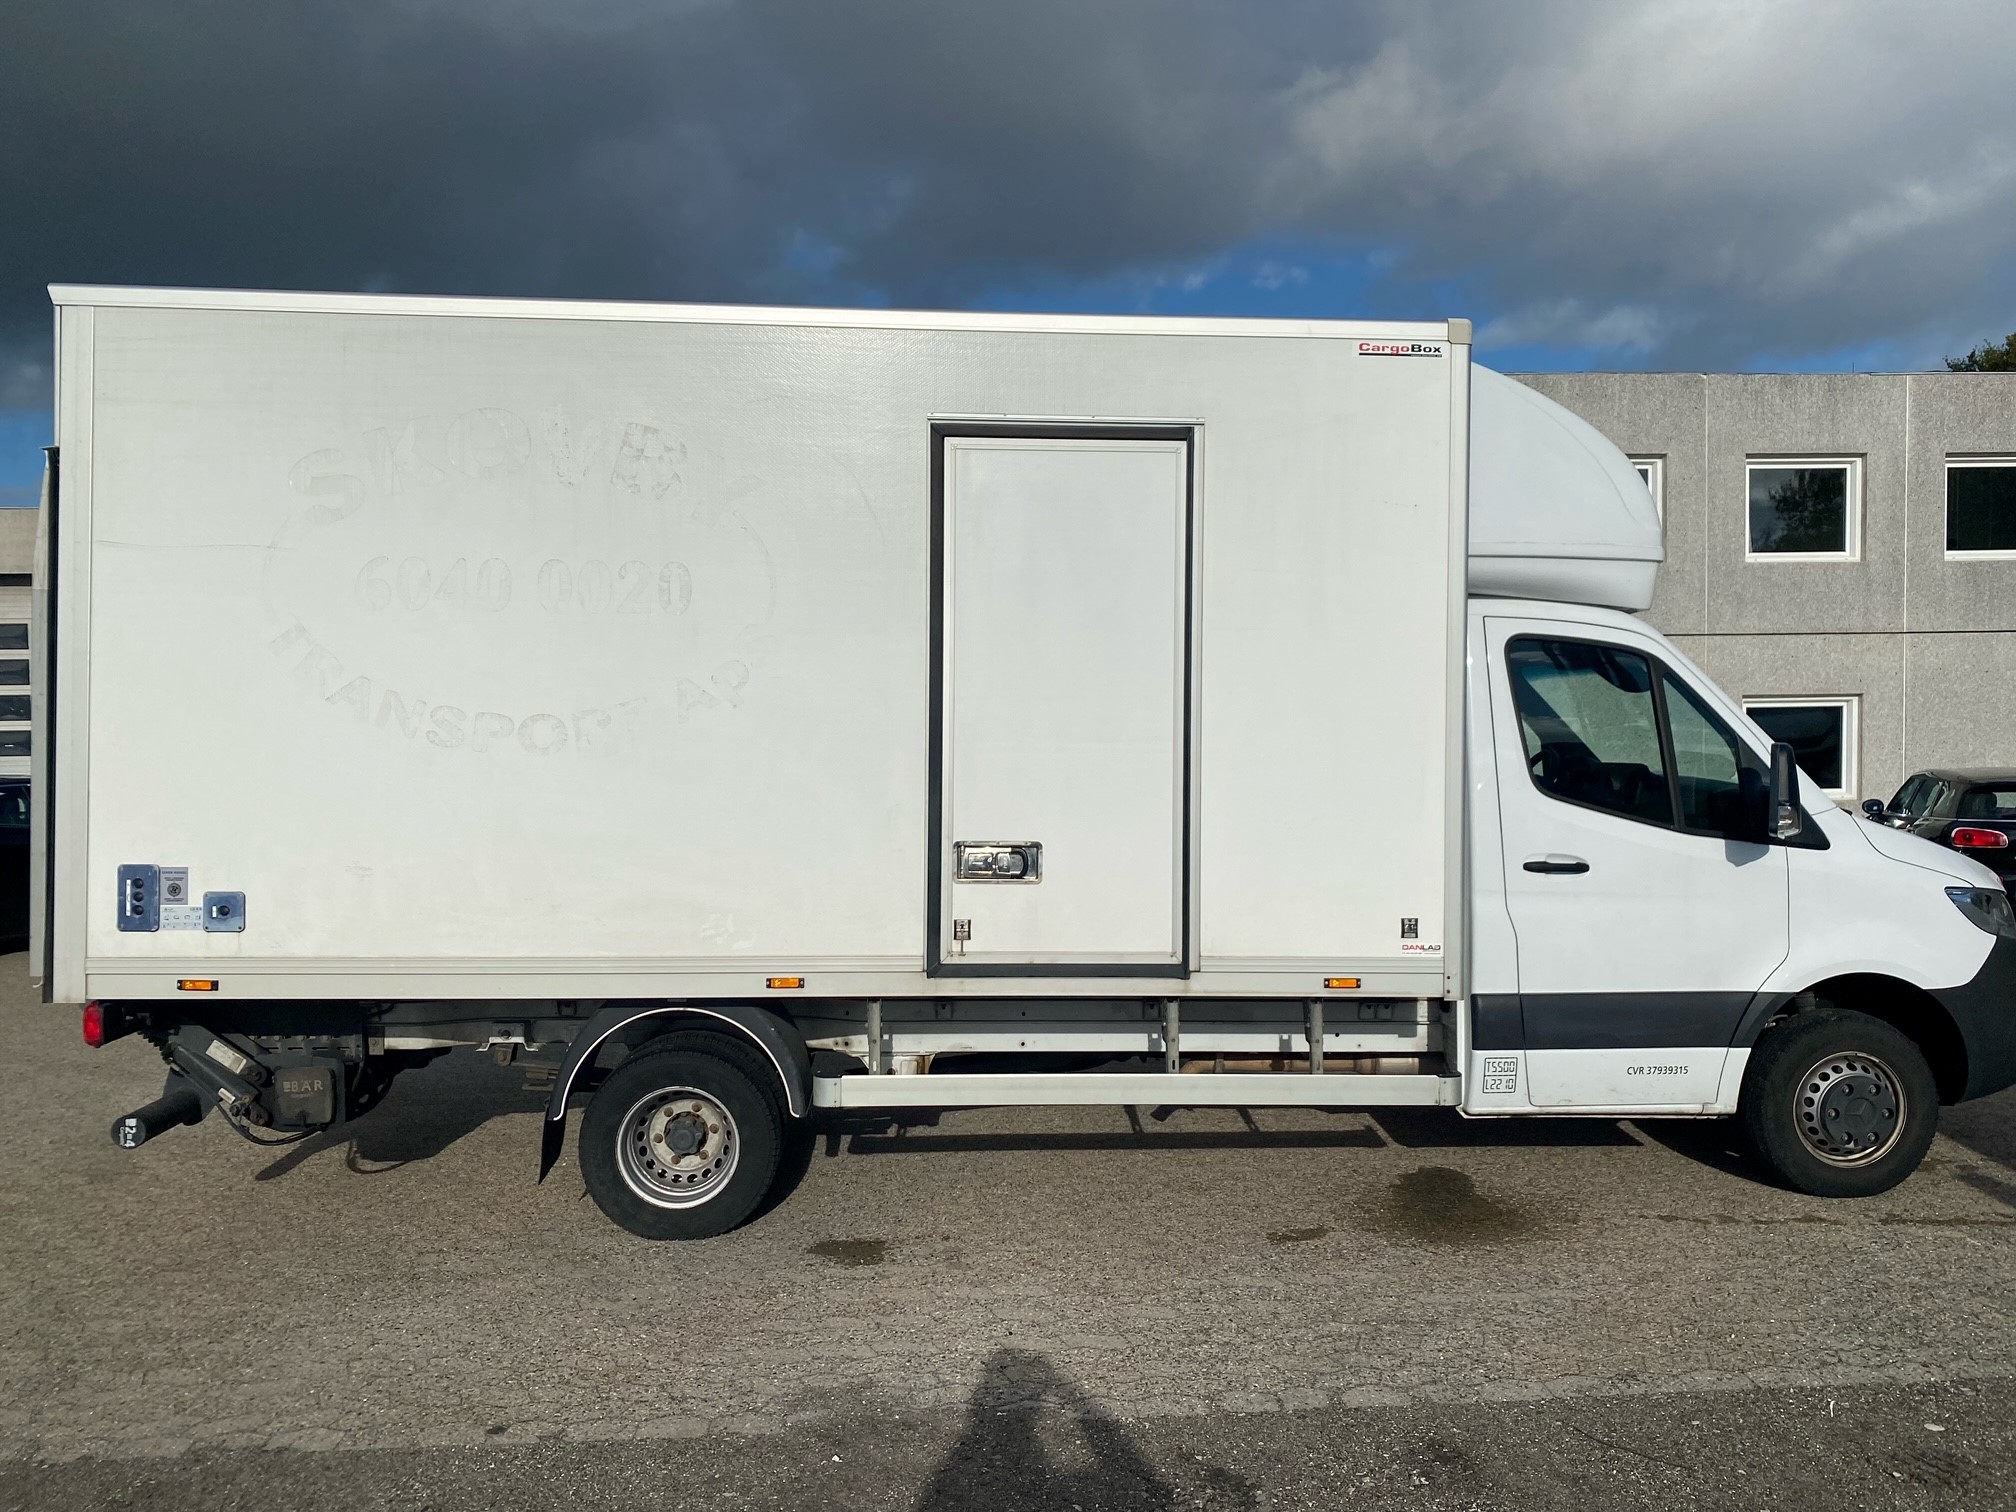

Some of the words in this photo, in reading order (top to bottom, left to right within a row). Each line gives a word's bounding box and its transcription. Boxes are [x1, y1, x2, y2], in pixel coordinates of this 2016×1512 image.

[1359, 343, 1442, 355] CargoBox
[354, 556, 513, 613] 6040
[537, 558, 693, 617] 0020
[1626, 1066, 1645, 1075] CVR
[1646, 1065, 1689, 1075] 37939315
